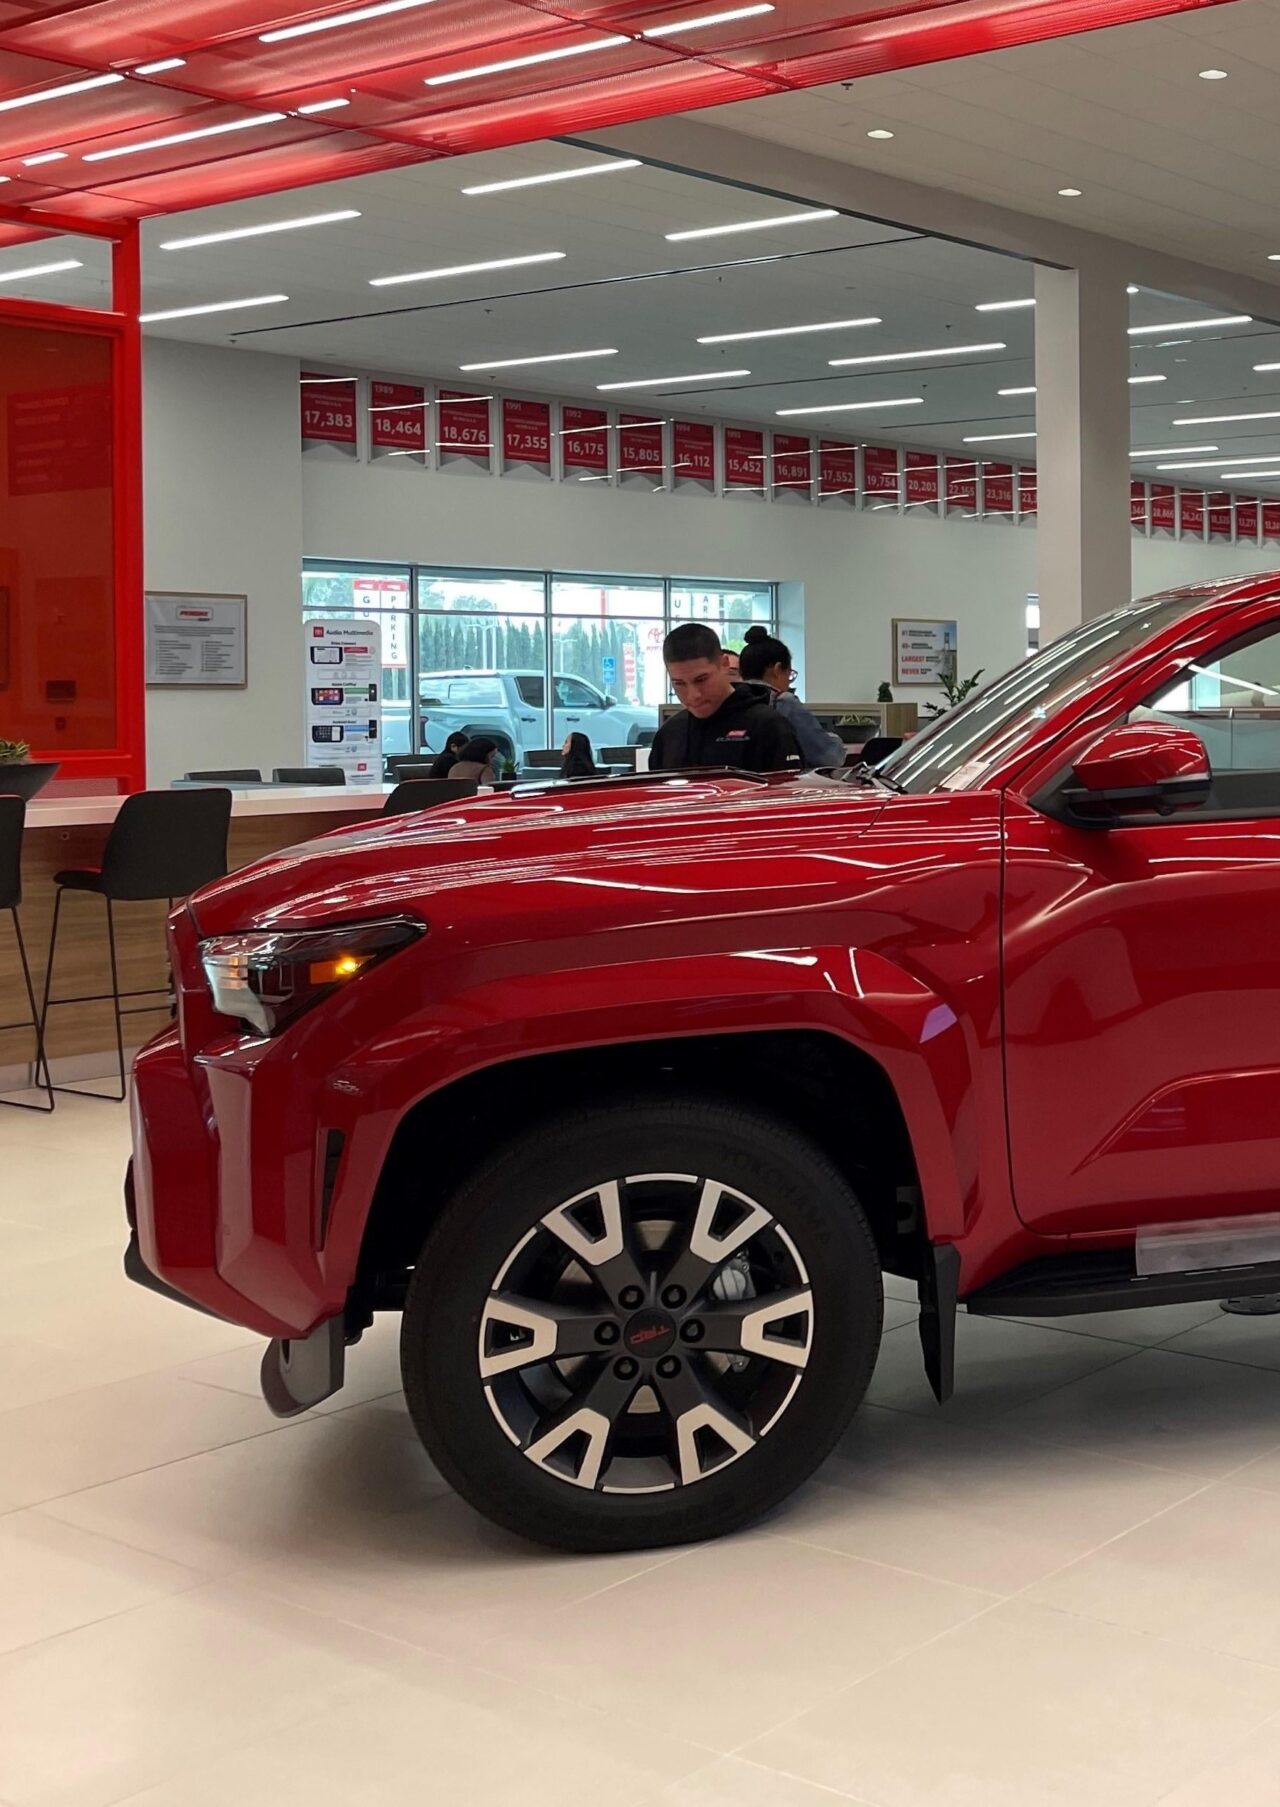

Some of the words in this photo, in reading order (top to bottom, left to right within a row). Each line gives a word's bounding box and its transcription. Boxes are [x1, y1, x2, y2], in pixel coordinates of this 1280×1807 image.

[304, 410, 353, 428] 17,383
[375, 418, 421, 436] 18,464
[443, 426, 487, 443] 18,676
[506, 433, 548, 450] 17,355
[567, 440, 605, 456] 16,175
[622, 446, 660, 462] 15,805
[678, 453, 711, 468] 16,112
[727, 459, 762, 474] 15,452
[777, 464, 808, 478] 16,891
[822, 469, 853, 483] 17,552
[867, 475, 896, 488] 19,754
[908, 479, 937, 492] 20,203
[390, 595, 398, 660] PRKING
